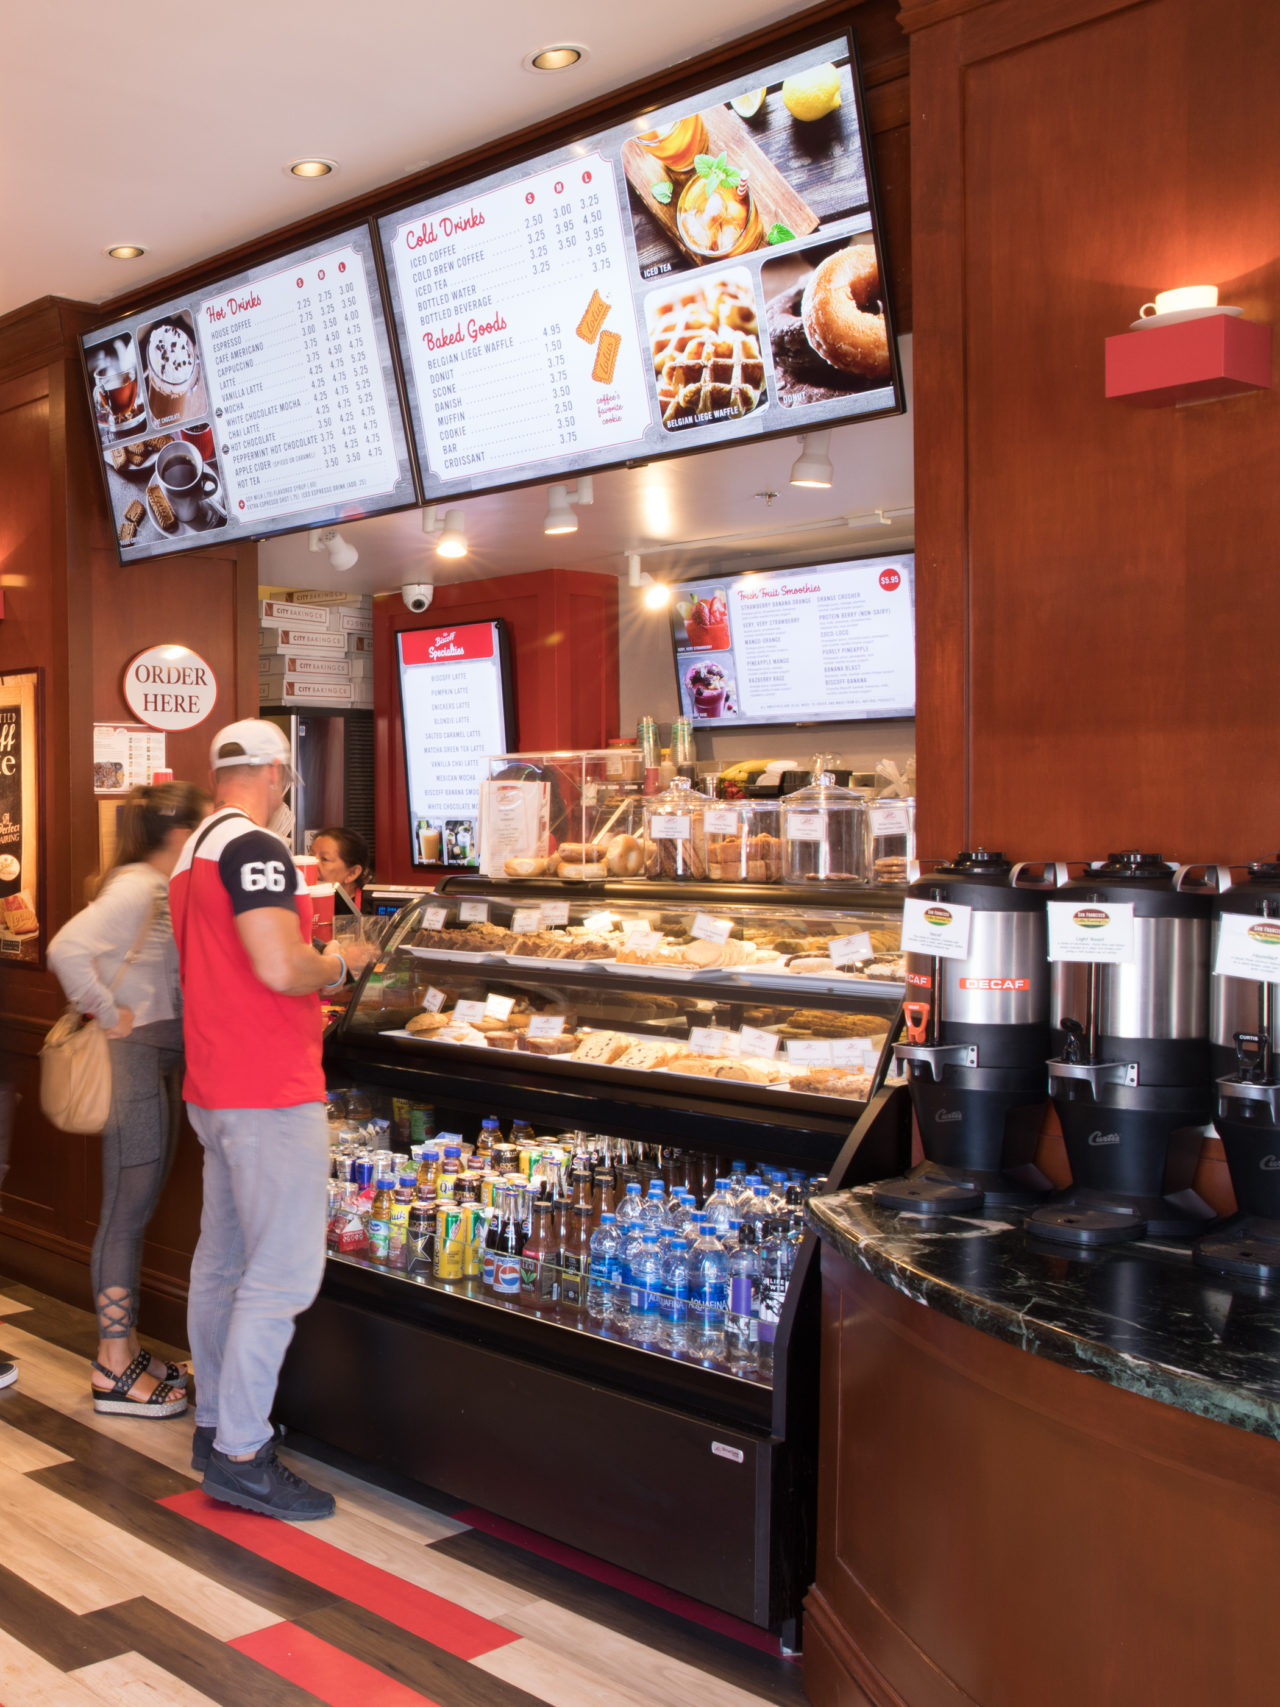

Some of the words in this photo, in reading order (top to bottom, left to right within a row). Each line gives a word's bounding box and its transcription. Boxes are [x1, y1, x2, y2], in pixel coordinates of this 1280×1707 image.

[406, 223, 438, 251] Cold
[439, 208, 485, 239] Drinks
[410, 256, 427, 268] ICED
[428, 246, 456, 262] COFFEE
[524, 215, 543, 229] 2.50
[552, 205, 572, 219] 3.00
[580, 195, 599, 209] 3.25
[412, 270, 432, 283] COLD
[433, 262, 455, 276] BREW
[456, 252, 484, 268] COFFEE
[527, 231, 545, 244] 3.25
[555, 221, 574, 235] 3.95
[582, 212, 602, 226] 4.50
[415, 285, 432, 297] ICED
[433, 280, 448, 291] TEA
[529, 247, 548, 260] 3.25
[557, 237, 576, 250] 3.50
[584, 228, 604, 241] 3.95
[644, 267, 658, 278] ICED
[659, 263, 672, 274] TEA
[417, 295, 449, 311] BOTTLED
[451, 286, 476, 301] WATER
[531, 262, 550, 275] 3.25
[587, 244, 606, 257] 3.95
[420, 310, 452, 326] BOTTLED
[453, 297, 492, 315] BEVERAGE
[592, 259, 611, 272] 3.75
[206, 305, 226, 324] Hot
[227, 292, 261, 316] Drinks
[210, 328, 229, 340] HOUSE
[230, 320, 251, 333] COFFEE
[423, 326, 465, 352] Baked
[467, 313, 507, 343] Goods
[212, 337, 241, 353] ESPRESSO
[214, 354, 229, 365] CAFE
[230, 343, 263, 360] AMERICANO
[427, 354, 459, 369] BELGIAN
[460, 348, 482, 360] LIEGE
[483, 339, 513, 353] WAFFLE
[542, 325, 561, 337] 4.95
[217, 360, 253, 378] CAPPUCCINO
[430, 371, 454, 383] DONUT
[432, 386, 456, 398] SCONE
[547, 356, 565, 367] 3.75
[219, 379, 236, 390] LATTE
[221, 389, 245, 402] VANILLA
[246, 384, 263, 395] LATTE
[224, 403, 244, 415] MOCHA
[226, 416, 244, 427] WHITE
[245, 406, 278, 422] CHOCOLATE
[279, 400, 300, 412] MOCHA
[434, 399, 462, 412] DANISH
[437, 413, 465, 426] MUFFIN
[552, 387, 570, 398] 3.50
[667, 414, 693, 428] BELGIAN
[695, 411, 713, 424] LIEGE
[714, 406, 738, 420] WAFFLE
[228, 430, 242, 440] CHAI
[242, 425, 260, 436] LATTE
[439, 428, 466, 440] COOKIE
[230, 443, 241, 452] HOT
[242, 434, 276, 449] CHOCOLATE
[232, 449, 269, 464] PEPPERMINT
[270, 445, 281, 455] HOT
[282, 436, 318, 451] CHOCOLATE
[442, 445, 457, 454] BAR
[235, 466, 252, 477] APPLE
[253, 462, 271, 472] CIDER
[444, 453, 485, 468] CROISSANT
[237, 480, 248, 489] HOT
[249, 477, 260, 486] TEA
[880, 575, 899, 585] $5.95
[781, 583, 821, 597] Smoothies
[428, 643, 465, 661] Specialties
[135, 664, 208, 686] ORDER
[143, 693, 200, 713] HERE
[241, 861, 285, 892] 66
[966, 980, 1024, 989] DECAF
[935, 1109, 962, 1122] Curtis
